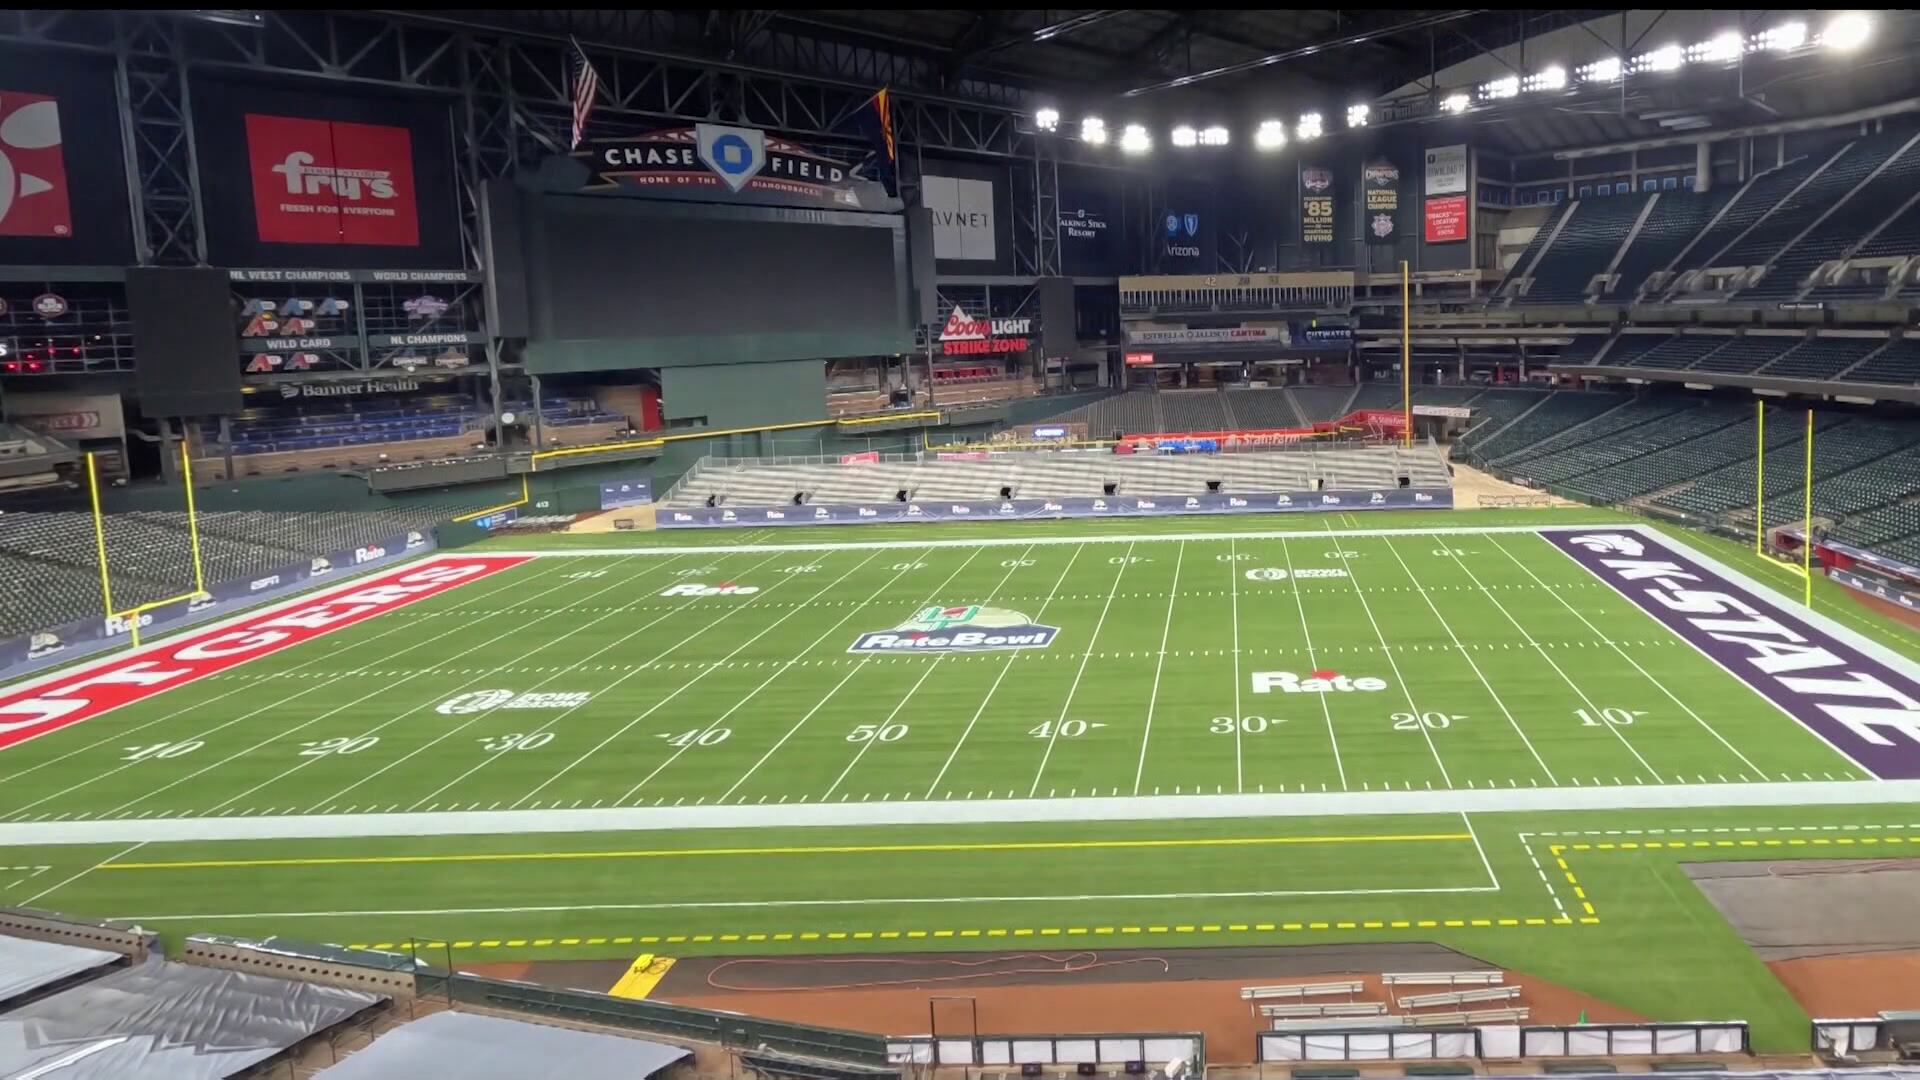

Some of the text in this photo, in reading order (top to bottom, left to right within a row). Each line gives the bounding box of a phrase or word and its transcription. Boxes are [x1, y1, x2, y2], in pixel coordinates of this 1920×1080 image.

[605, 148, 694, 166] CHASE
[272, 151, 398, 200] fry's
[772, 157, 843, 182] FIELD
[640, 176, 717, 185] HOME OF THE
[752, 180, 823, 197] DIAMONDBACKS
[230, 271, 351, 281] NL WEST CHAMPIONS
[373, 272, 467, 281] WORLD CHAMPIONS
[1204, 276, 1217, 286] 42
[943, 315, 1032, 336] Coors LIGHT
[1230, 329, 1267, 338] CANTINA
[266, 339, 331, 350] WILD CARD
[390, 334, 467, 345] NL CHAMPIONS
[943, 338, 1027, 355] STRIKE ZONE
[303, 379, 419, 398] Banner Health
[355, 547, 386, 563] Rate
[1252, 671, 1387, 693] Rate
[1210, 715, 1268, 734] 30
[1391, 711, 1451, 731] 20
[1573, 708, 1633, 727] 10
[667, 728, 732, 746] 40
[846, 724, 909, 742] 50
[1028, 719, 1087, 738] 40
[298, 736, 380, 756] 20
[484, 733, 555, 751] 30
